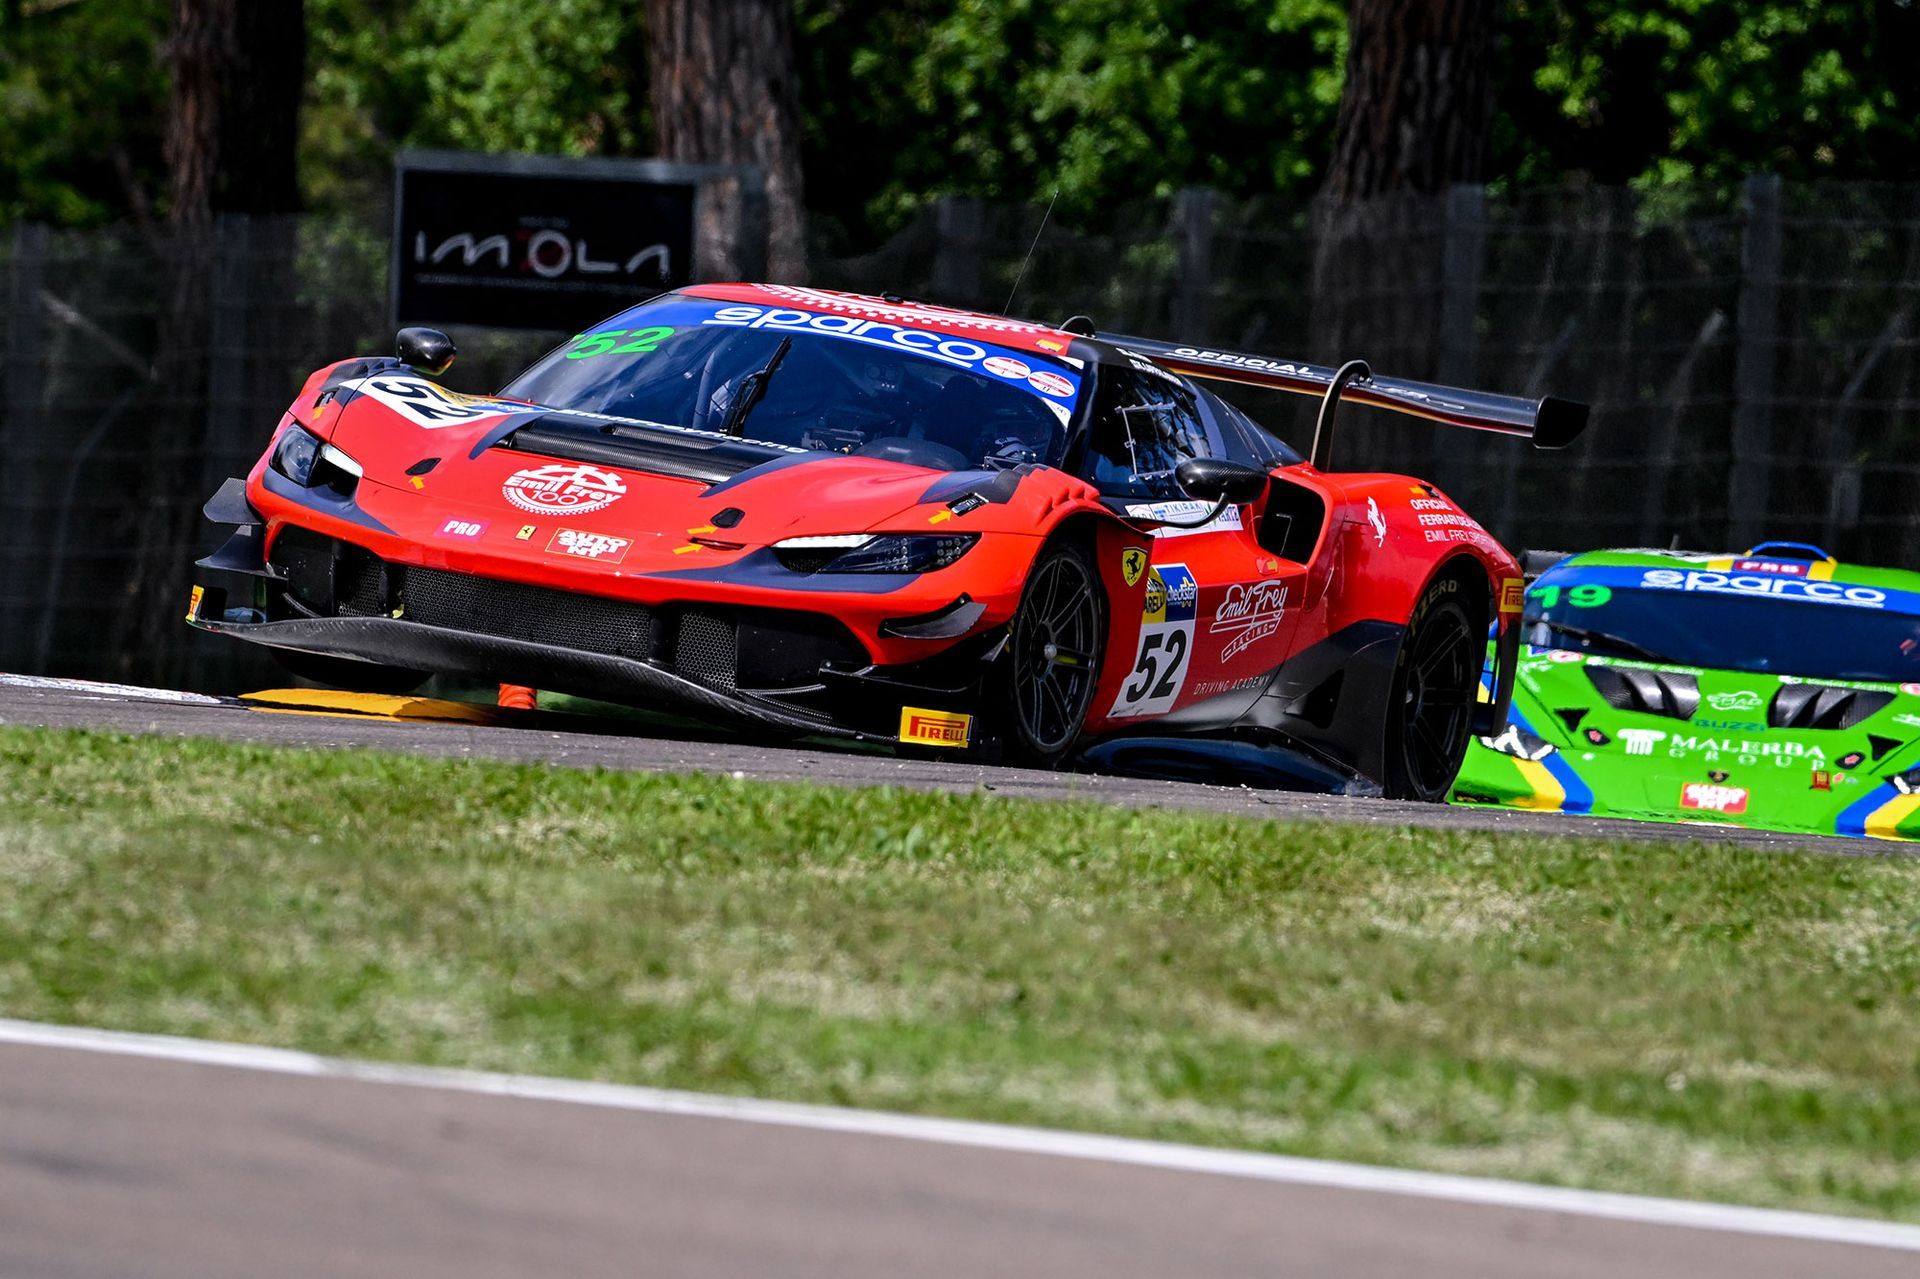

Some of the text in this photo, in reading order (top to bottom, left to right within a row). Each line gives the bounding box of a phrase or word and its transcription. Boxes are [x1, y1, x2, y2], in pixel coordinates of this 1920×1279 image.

[567, 326, 675, 361] 52
[712, 306, 987, 362] sparco
[1174, 347, 1315, 376] OFFICIAL
[504, 475, 623, 503] Emil Frey
[531, 490, 579, 505] 100
[443, 520, 482, 538] PRO
[1418, 514, 1459, 526] FERRARI
[1424, 529, 1450, 542] EMIL
[1529, 584, 1613, 609] 19
[1643, 569, 1886, 605] sparco
[1215, 584, 1253, 621] Emil
[1252, 579, 1288, 626] Frey
[1232, 623, 1268, 650] RACING
[1126, 628, 1187, 703] 52
[1193, 675, 1270, 695] DRIVING ACADEMY
[908, 715, 966, 742] PIRELLI
[1668, 748, 1825, 771] GROUP
[1671, 734, 1826, 760] MALERBA
